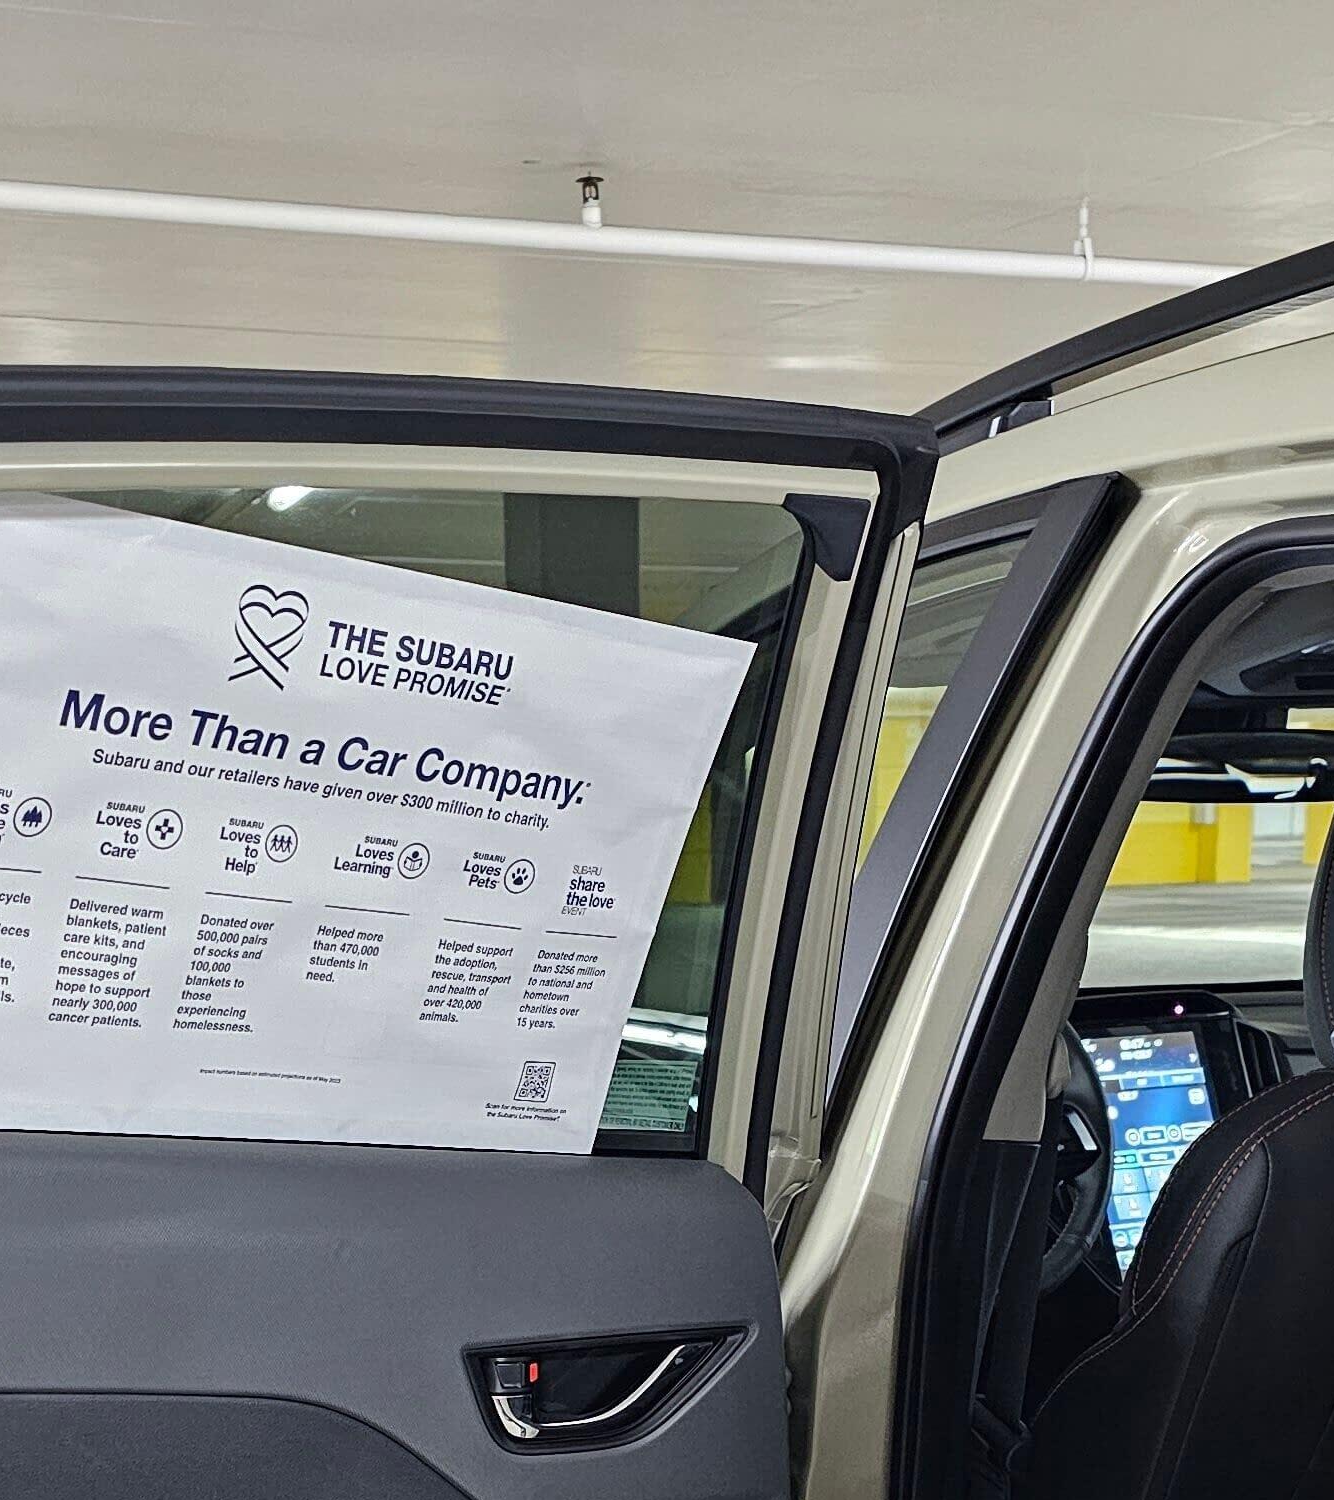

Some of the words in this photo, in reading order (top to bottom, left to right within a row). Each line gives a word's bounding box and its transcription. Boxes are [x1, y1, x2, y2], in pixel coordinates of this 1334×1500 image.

[328, 620, 389, 658] THE
[395, 635, 514, 681] SUBARU
[319, 653, 390, 687] LOVE
[392, 667, 505, 706] PROMISE
[59, 689, 173, 741] More
[191, 709, 290, 760] Than
[299, 739, 326, 766] a
[337, 736, 408, 777] Car
[415, 747, 588, 810] Company.
[92, 748, 151, 770] Subaru
[153, 759, 185, 774] and
[187, 764, 216, 778] our
[217, 768, 280, 788] retailers
[283, 775, 320, 794] have
[321, 782, 363, 800] given
[366, 791, 399, 805] over
[400, 793, 434, 810] $300
[435, 799, 484, 819] million
[487, 807, 501, 821] to
[504, 810, 549, 831] charity.
[106, 801, 146, 814] SUBARU
[95, 810, 142, 830] Loves
[229, 817, 265, 830] SUBARU
[124, 830, 139, 845] to
[219, 826, 262, 845] Loves
[364, 835, 399, 848] SUBARU
[100, 841, 138, 859] Care
[244, 845, 259, 859] to
[355, 843, 395, 862] Loves
[472, 851, 506, 864] SUBARU
[224, 857, 258, 876] Help
[333, 856, 392, 879] Learning
[462, 859, 502, 877] Loves
[572, 864, 603, 876] SUBARU
[468, 874, 499, 890] Pets
[569, 876, 606, 893] share
[69, 898, 129, 916] Delivered
[131, 907, 164, 920] warm
[66, 914, 121, 933] blankets,
[124, 922, 167, 937] patient
[200, 913, 249, 929] Donated
[249, 921, 275, 931] over
[196, 929, 240, 944] 500,000
[240, 934, 268, 947] pairs
[316, 924, 356, 940] Helped
[356, 931, 384, 942] more
[63, 933, 91, 944] care
[93, 933, 119, 949] kits,
[121, 939, 146, 950] and
[313, 940, 337, 952] than
[339, 942, 380, 957] 470,000
[437, 938, 475, 954] Helped
[475, 945, 514, 958] support
[60, 949, 138, 968] encouraging
[193, 945, 206, 956] of
[207, 947, 240, 959] socks
[241, 949, 263, 960] and
[537, 949, 576, 961] Donated
[575, 954, 598, 963] more
[190, 960, 231, 973] 100,000
[309, 956, 356, 969] students
[357, 959, 368, 971] in
[434, 954, 452, 966] the
[453, 956, 497, 972] adoption,
[532, 963, 553, 973] than
[553, 964, 576, 975] $256
[576, 967, 606, 977] million
[57, 965, 120, 982] messages
[122, 970, 136, 981] of
[185, 974, 231, 988] blankets
[233, 978, 245, 988] to
[305, 971, 335, 983] need.
[431, 970, 466, 982] rescue,
[468, 972, 512, 986] transport
[55, 979, 86, 994] hope
[89, 983, 102, 994] to
[104, 986, 151, 999] support
[427, 983, 447, 994] and
[447, 984, 477, 996] health
[478, 986, 490, 996] of
[527, 977, 538, 986] to
[538, 978, 576, 988] national
[575, 980, 594, 990] and
[181, 989, 212, 1002] those
[523, 989, 570, 1002] hometown
[52, 997, 90, 1011] nearly
[92, 998, 138, 1012] 300,000
[176, 1005, 247, 1020] experiencing
[423, 998, 446, 1008] over
[446, 998, 482, 1011] 420,000
[519, 1003, 558, 1015] charities
[559, 1007, 580, 1016] over
[48, 1012, 90, 1023] cancer
[90, 1015, 142, 1028] patients.
[419, 1011, 459, 1023] animals.
[517, 1017, 527, 1027] 15
[528, 1020, 555, 1030] years.
[172, 1018, 253, 1033] homelessness.
